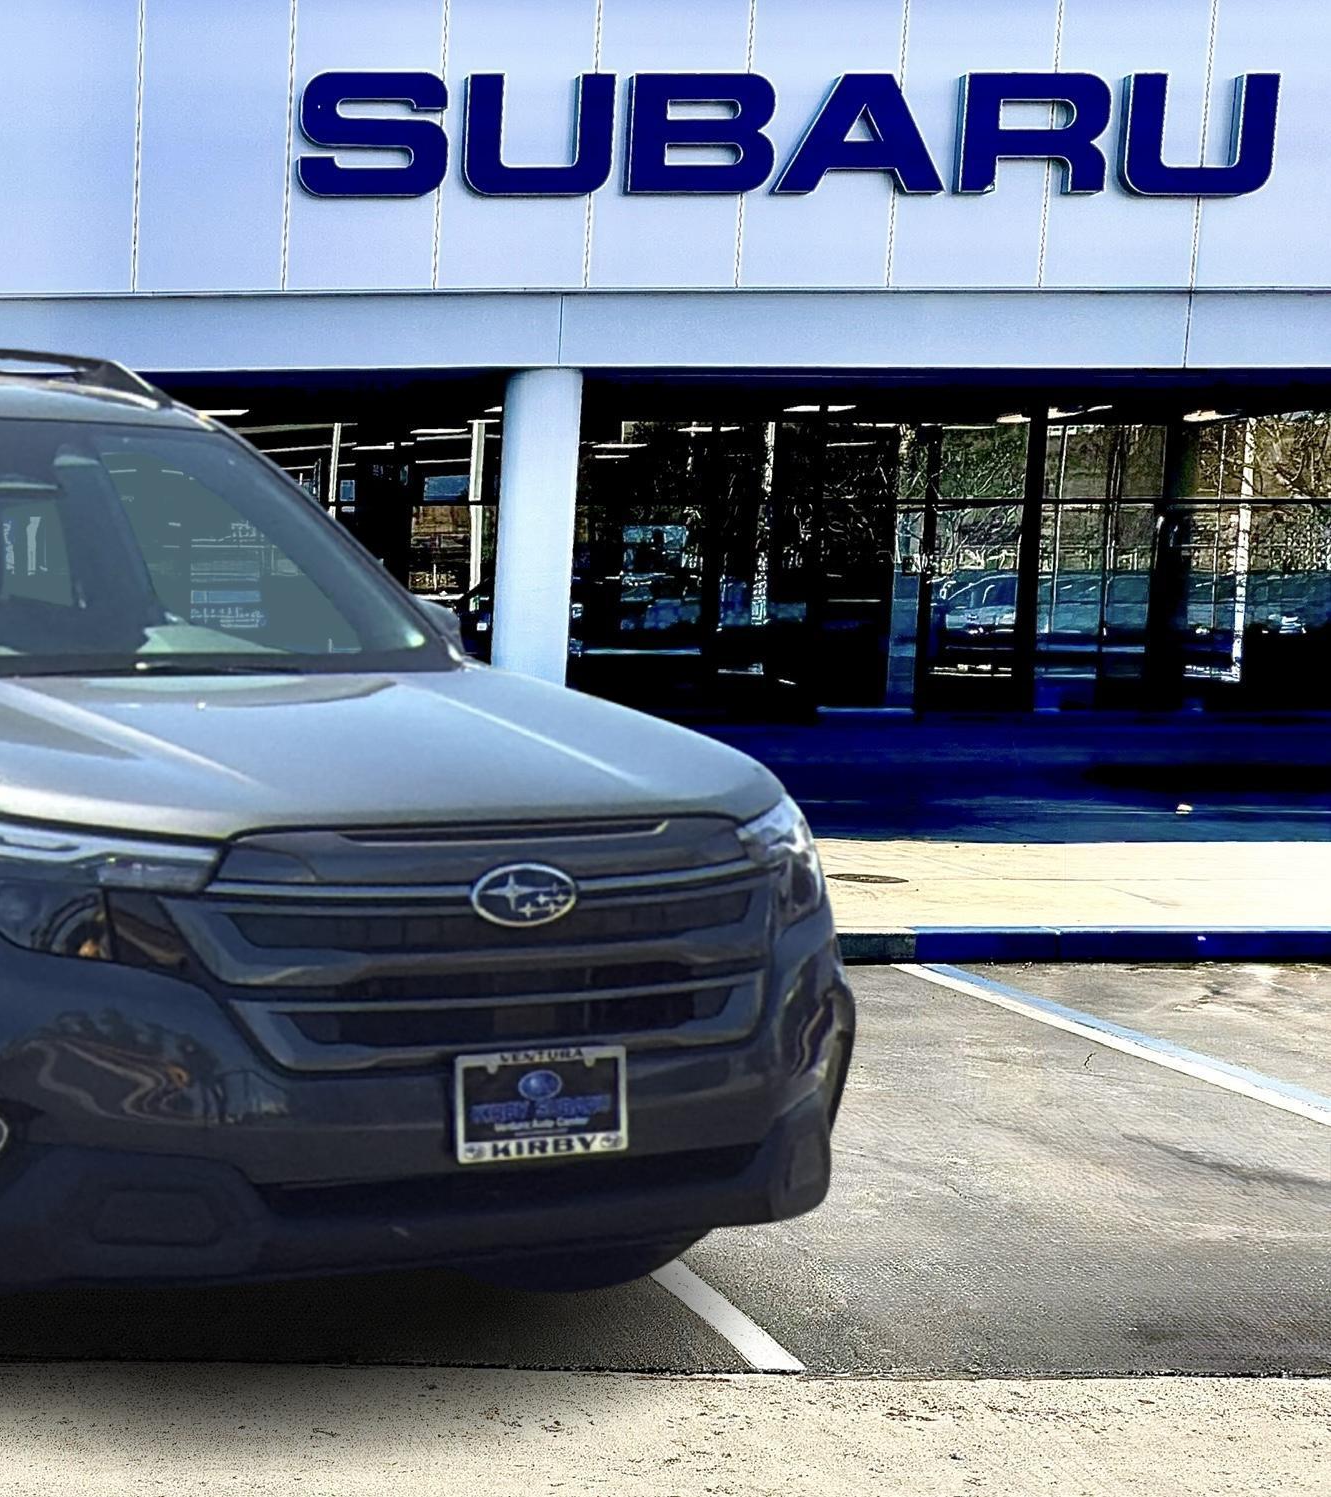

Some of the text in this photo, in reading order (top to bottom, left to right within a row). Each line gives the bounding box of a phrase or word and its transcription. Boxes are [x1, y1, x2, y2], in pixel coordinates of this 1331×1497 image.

[295, 70, 1282, 198] SUBARU
[499, 1047, 584, 1064] VENTURA
[491, 1134, 597, 1158] KIRBY
